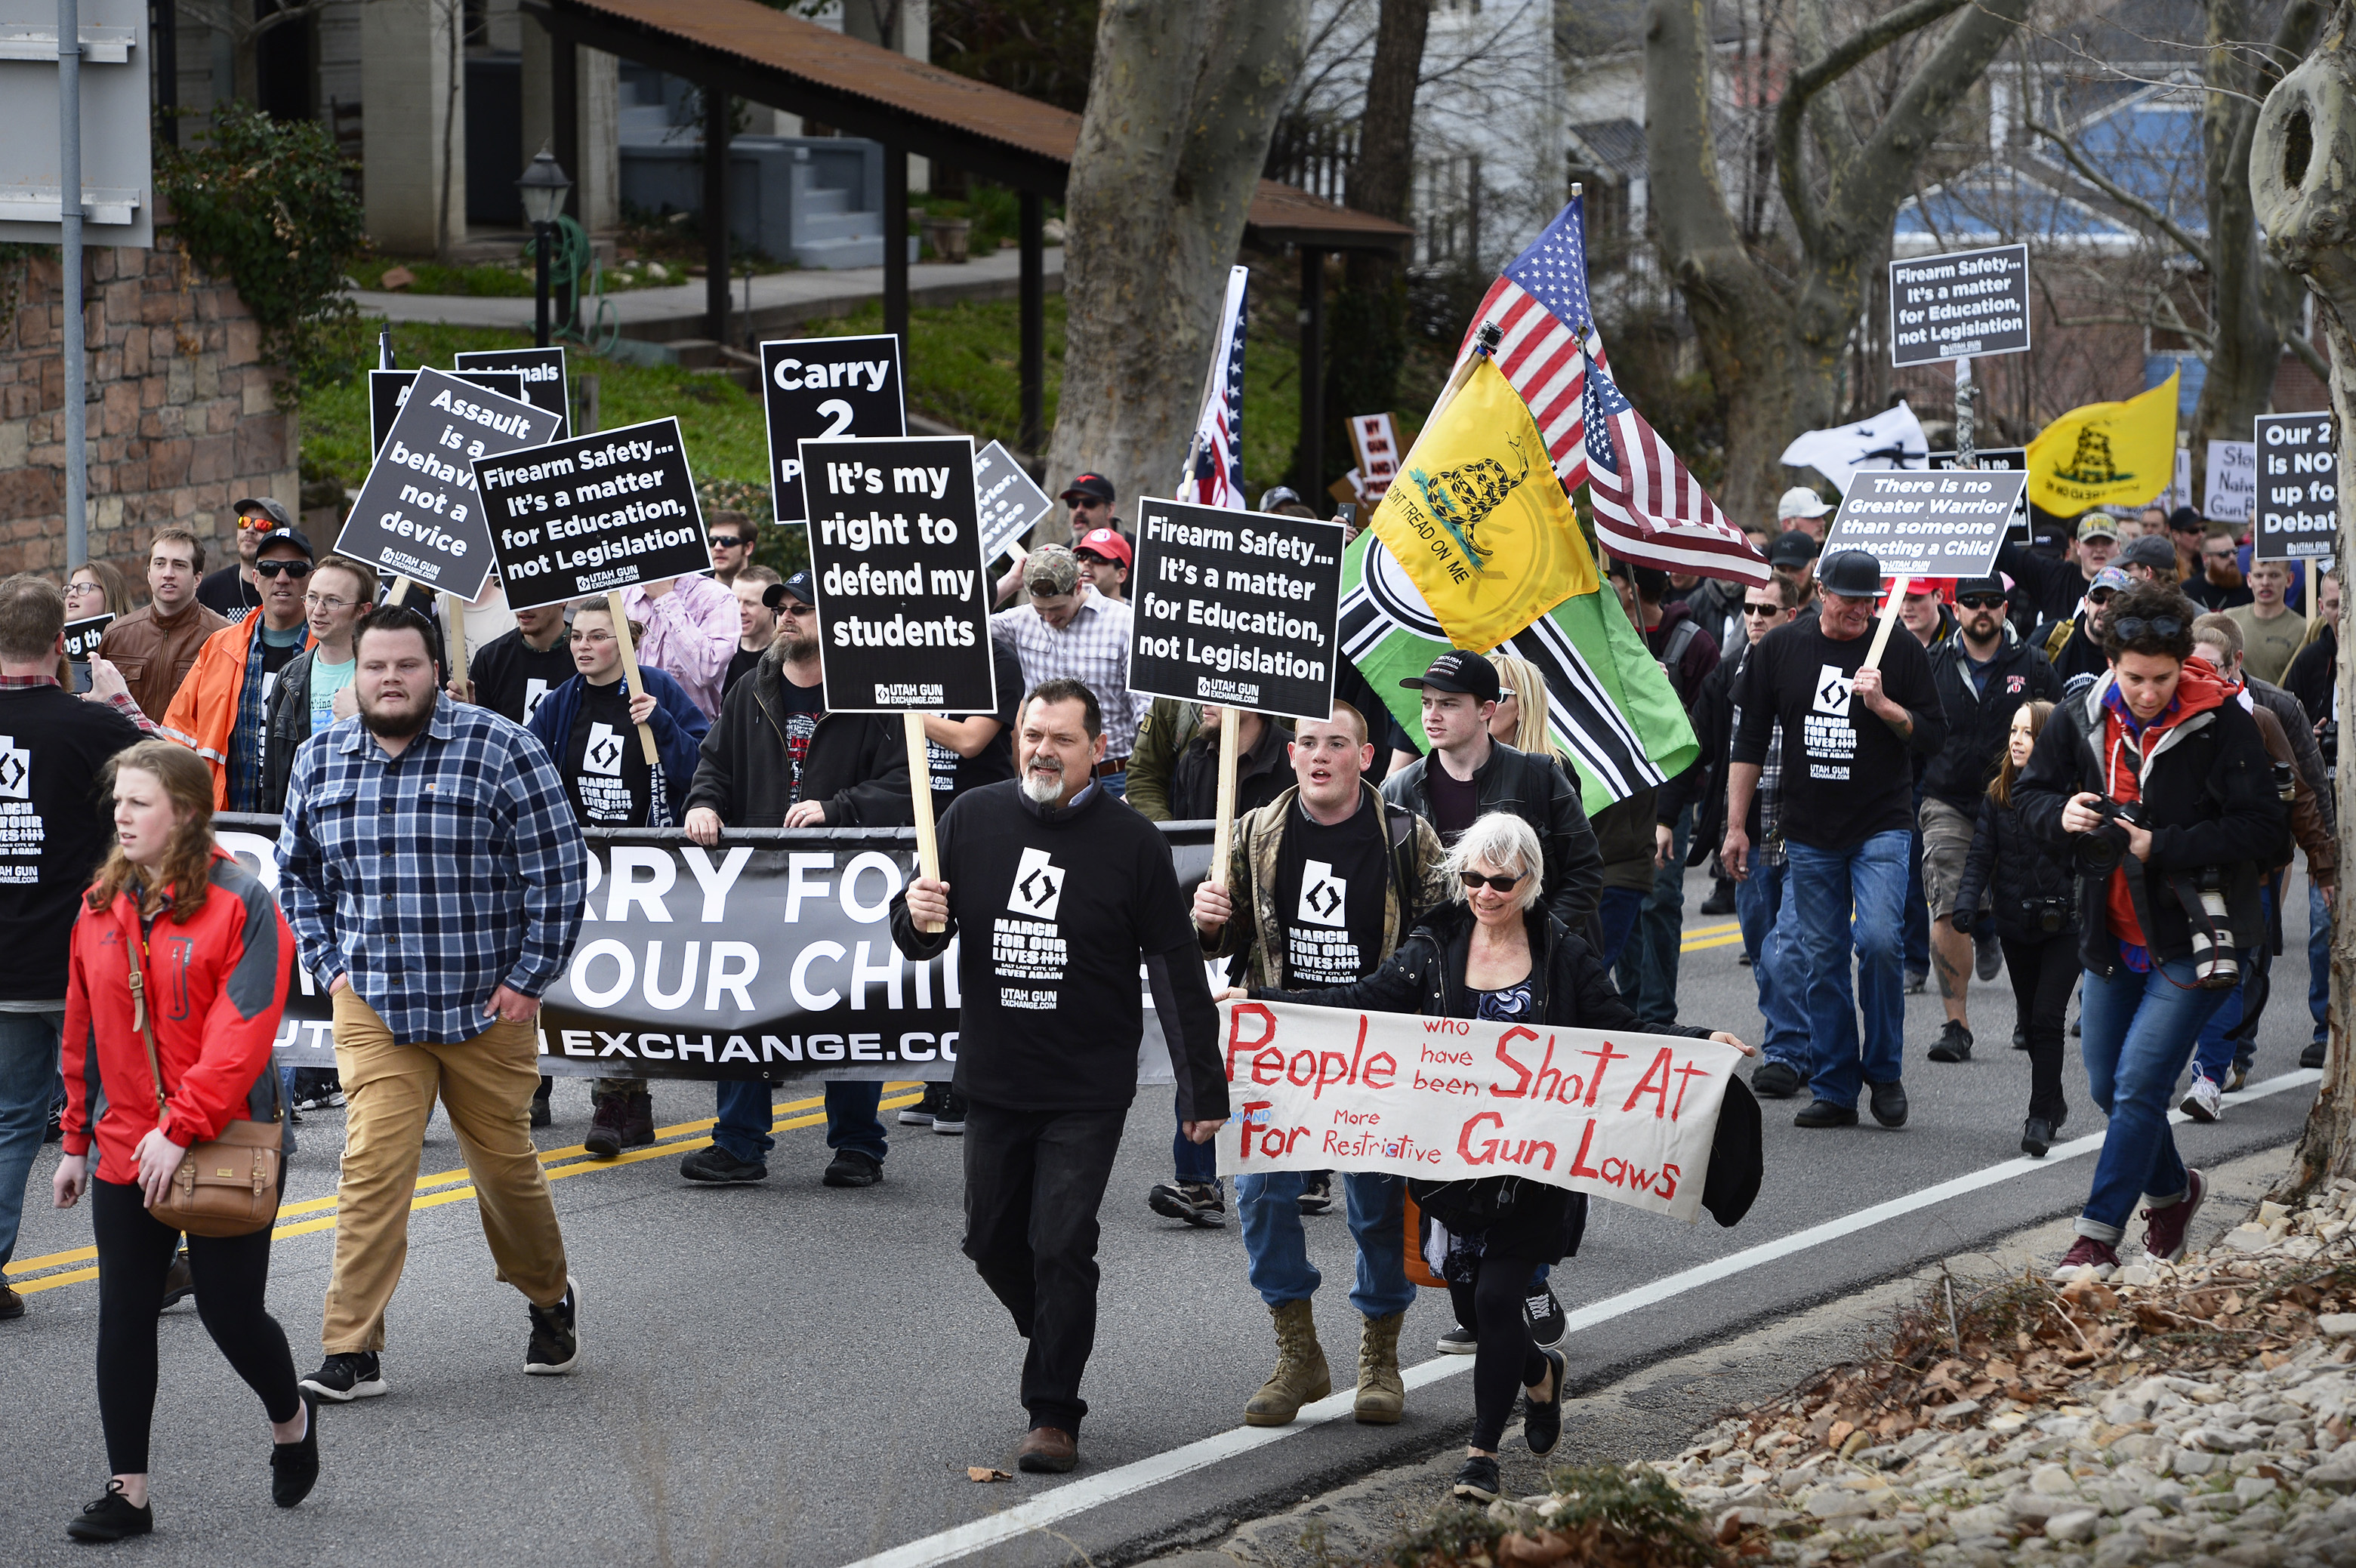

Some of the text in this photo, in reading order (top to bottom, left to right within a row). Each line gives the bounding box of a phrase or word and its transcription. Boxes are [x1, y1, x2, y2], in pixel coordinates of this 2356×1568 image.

[1896, 257, 2021, 285] Firearm Safety...
[1907, 277, 2012, 303] It's a matter
[1898, 297, 2021, 325] for Education,
[1898, 316, 2023, 346] not Legislation
[773, 359, 890, 392] Carry
[429, 389, 531, 439] Assault
[816, 399, 856, 438] 2
[439, 424, 486, 457] is a
[2265, 422, 2332, 446] Our 2
[483, 440, 674, 490] Firearm Safety...
[2268, 451, 2337, 475] is NO
[827, 461, 884, 494] It's
[893, 467, 950, 499] my
[1873, 478, 1992, 493] There is no
[399, 484, 468, 522] not a
[507, 469, 665, 517] It's a matter
[2271, 485, 2303, 507] up
[2308, 480, 2337, 503] fo
[1848, 498, 1925, 514] Greater
[1929, 498, 2007, 514] Warrior
[380, 510, 467, 557] device
[501, 498, 686, 550] for Education,
[821, 511, 909, 551] right
[918, 512, 958, 544] to
[982, 503, 1025, 544] evice
[1841, 519, 1997, 534] than someone
[2265, 510, 2337, 534] Debat
[1147, 515, 1334, 566] Firearm Safety...
[1401, 501, 1435, 540] TREAD
[1431, 541, 1452, 561] ON
[1446, 560, 1469, 584] ME
[1928, 544, 1939, 555] a
[1944, 541, 1994, 556] Child
[394, 551, 441, 575] UTAH GUN
[507, 527, 696, 581] not Legislation
[392, 559, 438, 581] EXCHANGE.COM
[589, 565, 639, 584] UTAH GUN
[591, 573, 640, 590] EXCHANGE.COM
[823, 562, 974, 602] defend my
[1160, 556, 1315, 601] It's a matter
[834, 614, 975, 647] students
[1144, 592, 1324, 647] for Education,
[1139, 635, 1324, 682] not Legislation
[890, 684, 943, 696] UTAH GUN
[1210, 690, 1258, 704] EXCHANGE.COM
[1211, 679, 1259, 696] UTAH GUN
[890, 696, 944, 704] EXCHANGE.COM
[1804, 715, 1849, 729] MARCH
[1804, 725, 1857, 739] FOR OUR
[1804, 735, 1836, 748] LIVES
[1810, 763, 1849, 774] UTAH GUN
[577, 776, 622, 789] MARCH
[579, 787, 631, 799] FOR OUR
[581, 796, 610, 810] LIVES
[8, 815, 42, 828] OUR
[11, 847, 42, 855] AGAIN
[14, 865, 38, 876] GUN
[784, 851, 919, 924] FO
[994, 918, 1058, 937] MARCH
[1289, 926, 1349, 944] MARCH
[993, 933, 1067, 953] FOR OUR
[1290, 938, 1359, 957] FOR OUR
[992, 947, 1039, 965] LIVES
[1290, 952, 1331, 970] LIVES
[569, 938, 760, 1012] OUR
[995, 967, 1063, 980] NEVER AGAIN
[1294, 970, 1357, 984] NEVER AGAIN
[1001, 987, 1057, 1003] UTAH GUN
[1001, 998, 1056, 1010] EXCHANGE.COM
[1423, 1016, 1470, 1036] who
[1226, 1003, 1397, 1100] People
[1420, 1043, 1473, 1066] have
[1413, 1069, 1478, 1096] been
[1334, 1109, 1380, 1125] More
[1240, 1101, 1310, 1161] For
[1323, 1130, 1442, 1163] Restrictive
[1457, 1111, 1681, 1200] Gun Laws
